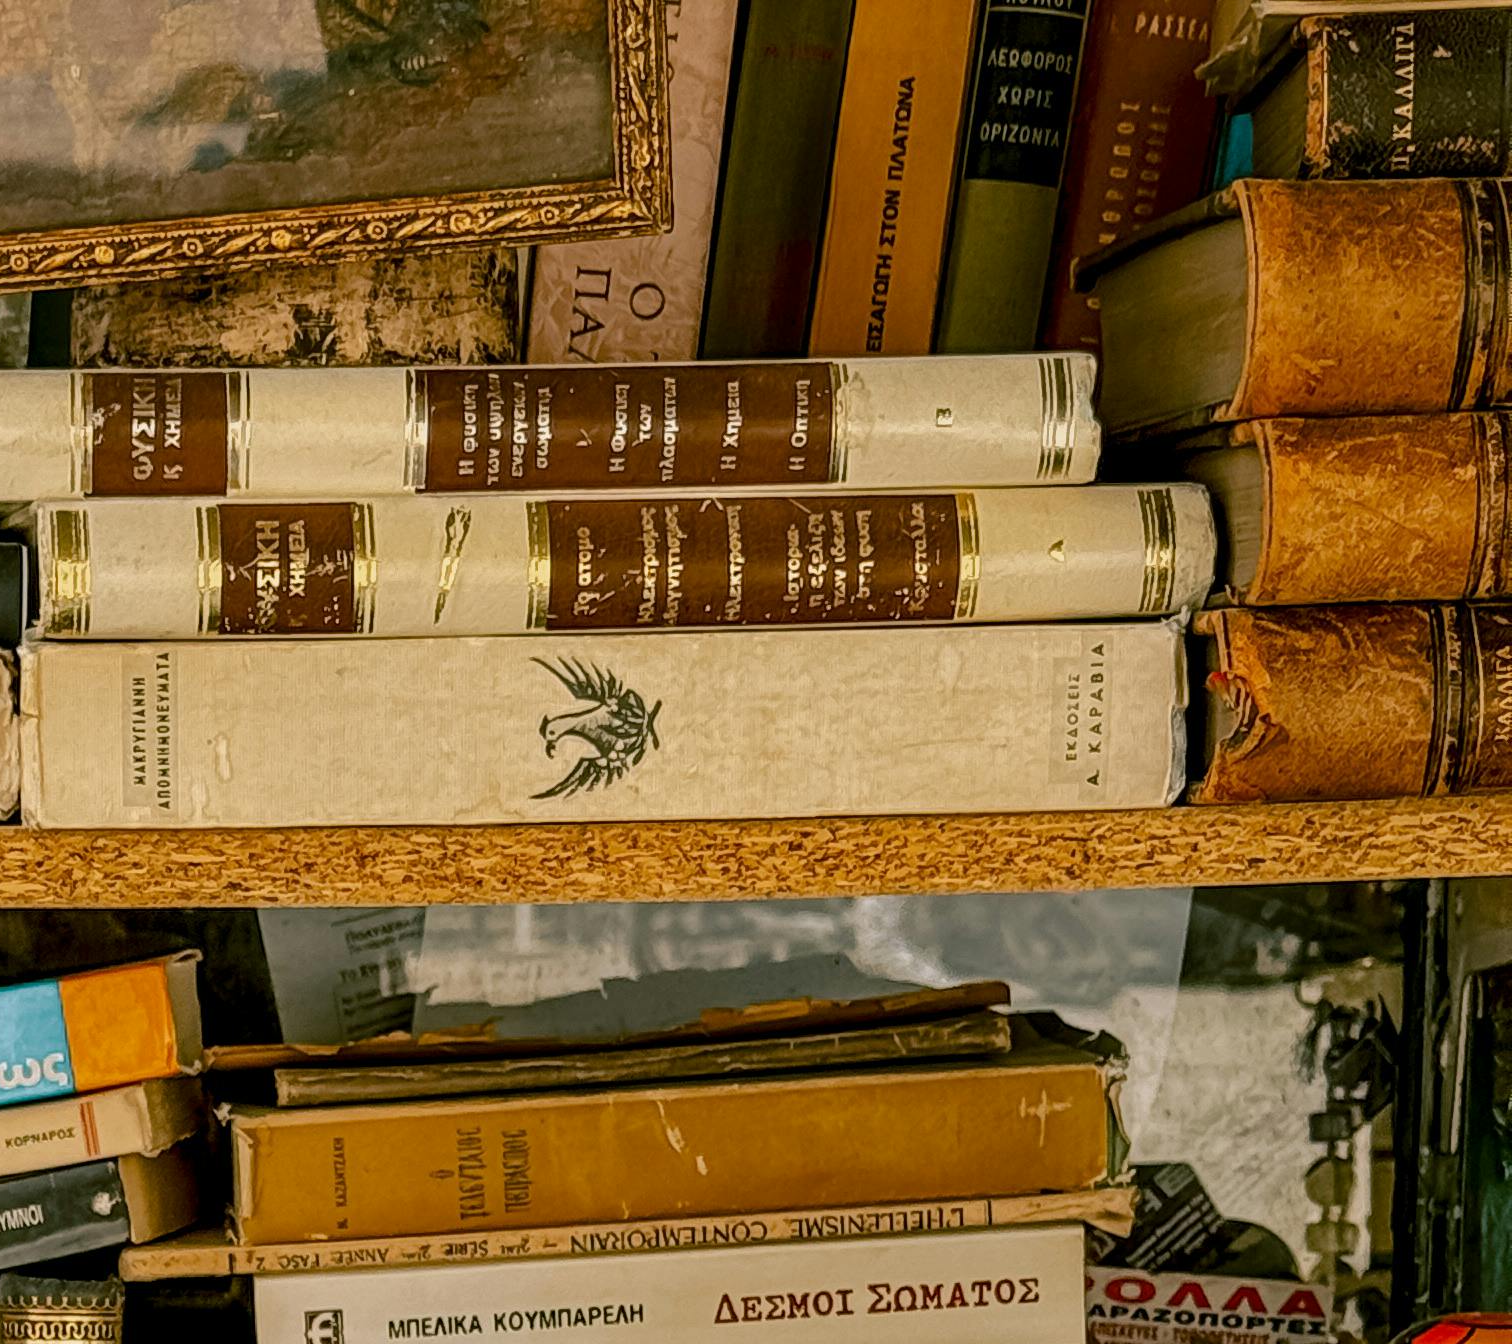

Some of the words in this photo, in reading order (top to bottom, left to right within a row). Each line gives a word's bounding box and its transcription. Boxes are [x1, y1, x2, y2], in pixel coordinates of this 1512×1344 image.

[887, 76, 916, 181] ΠΛΑΤΩΝΑ
[998, 86, 1052, 110] ΧΩΡΙΣ
[980, 123, 1060, 147] ΟΡΙΖΟΝΤΑ
[878, 190, 901, 247] ΣΤΟΝ
[866, 253, 892, 353] ΕΙΣΑΓΩΓΗ
[131, 676, 146, 785] ΜΑΚΡΥΓΙΑΝΝΗ
[157, 652, 171, 809] ΑΠΟΜΝΗΜΟΝΕΥΜΑΤΑ
[4, 1127, 76, 1150] ΚΟΡΝΑΡΟΣ
[388, 1309, 483, 1339] ΜΠΕΛΙΚΑ
[493, 1302, 644, 1333] ΚΟΥΜΠΑΡΕΛΗ
[713, 1284, 854, 1325] ΔΕΣΜΟΙ
[866, 1277, 1041, 1314] ΣΩΜΑΤΟΣ
